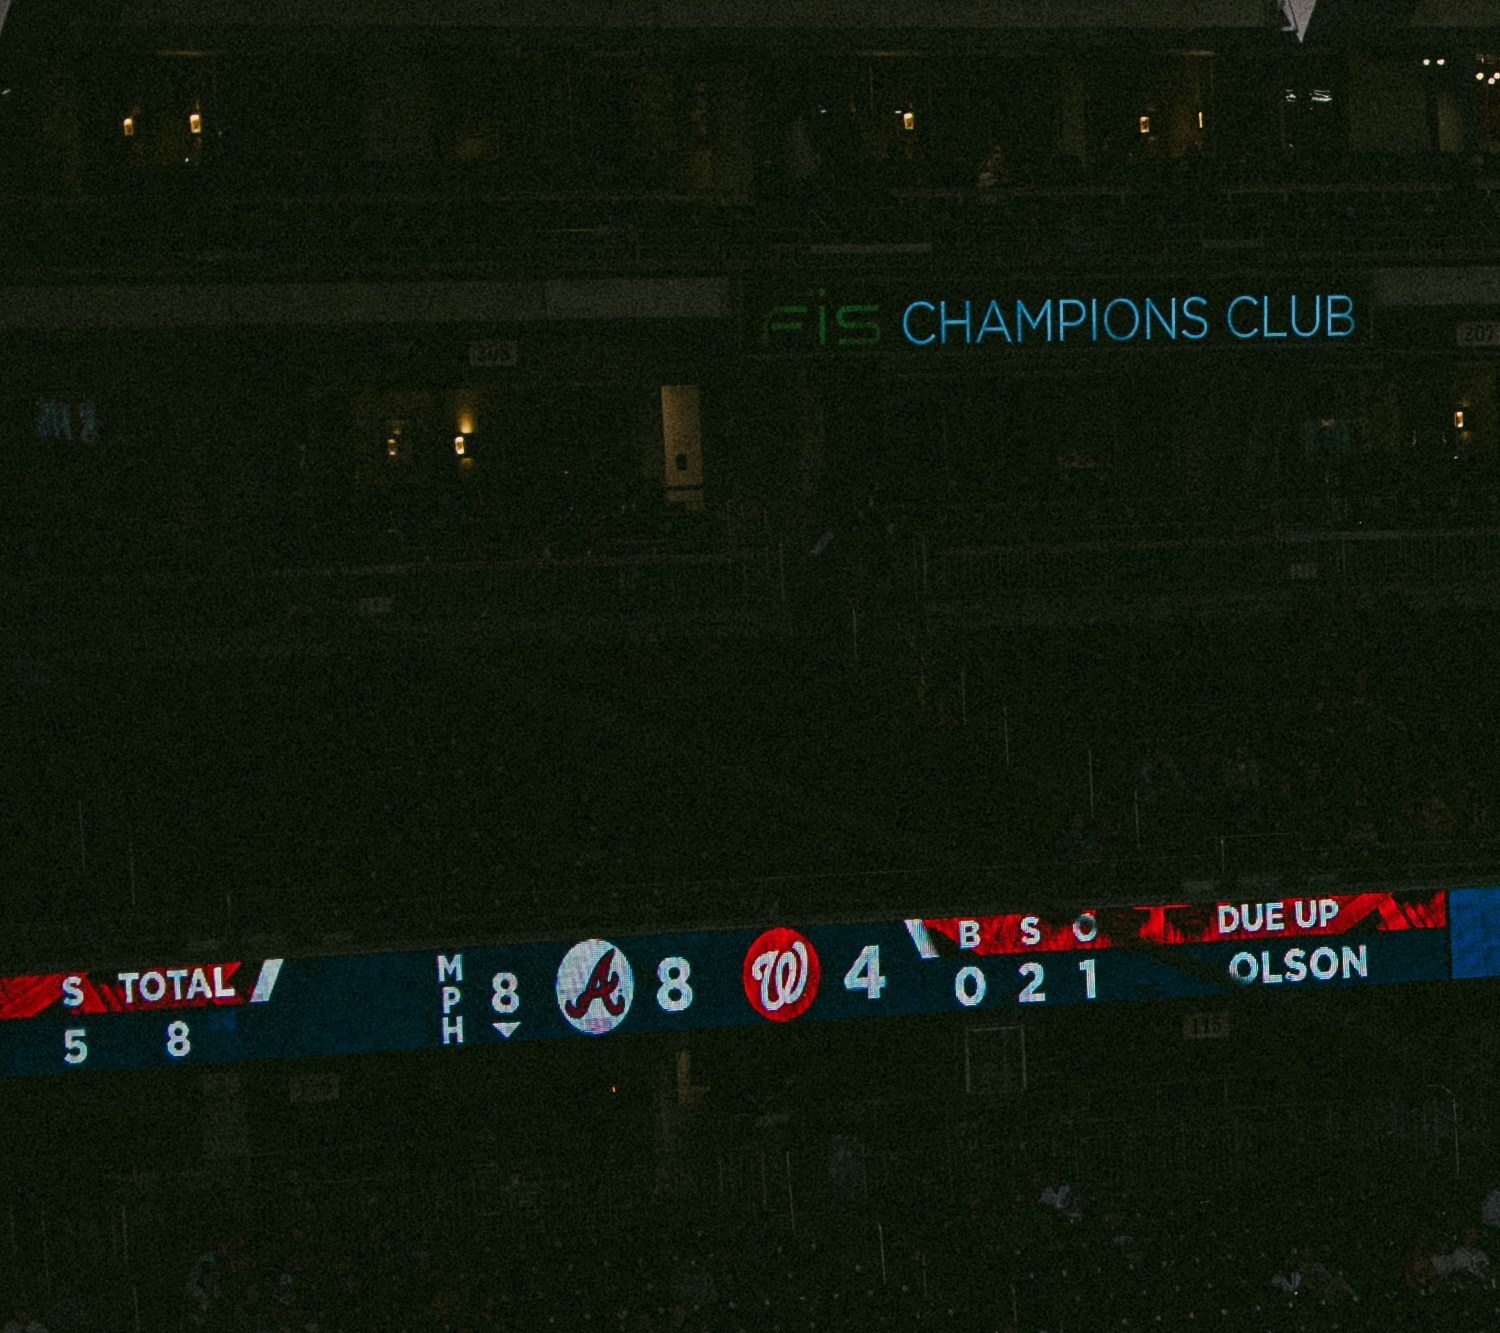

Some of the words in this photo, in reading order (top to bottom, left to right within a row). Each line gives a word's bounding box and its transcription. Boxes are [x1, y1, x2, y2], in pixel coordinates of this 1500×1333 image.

[902, 296, 1210, 346] CHAMPIONS
[1226, 293, 1358, 340] CLUB
[958, 919, 982, 950] B
[1020, 915, 1043, 946] S
[1073, 912, 1098, 943] O
[1217, 901, 1285, 934] DUE
[1294, 898, 1340, 929] UP
[62, 976, 84, 1007] S
[118, 966, 237, 1005] TOTAL
[491, 972, 521, 1014] 8
[656, 956, 694, 1012] 8
[843, 944, 887, 999] 4
[955, 965, 986, 1007] 0
[1017, 962, 1047, 1004] 2
[1078, 959, 1098, 1000] 1
[1228, 944, 1368, 987] OLSON
[63, 1028, 89, 1065] 5
[166, 1021, 191, 1058] 8
